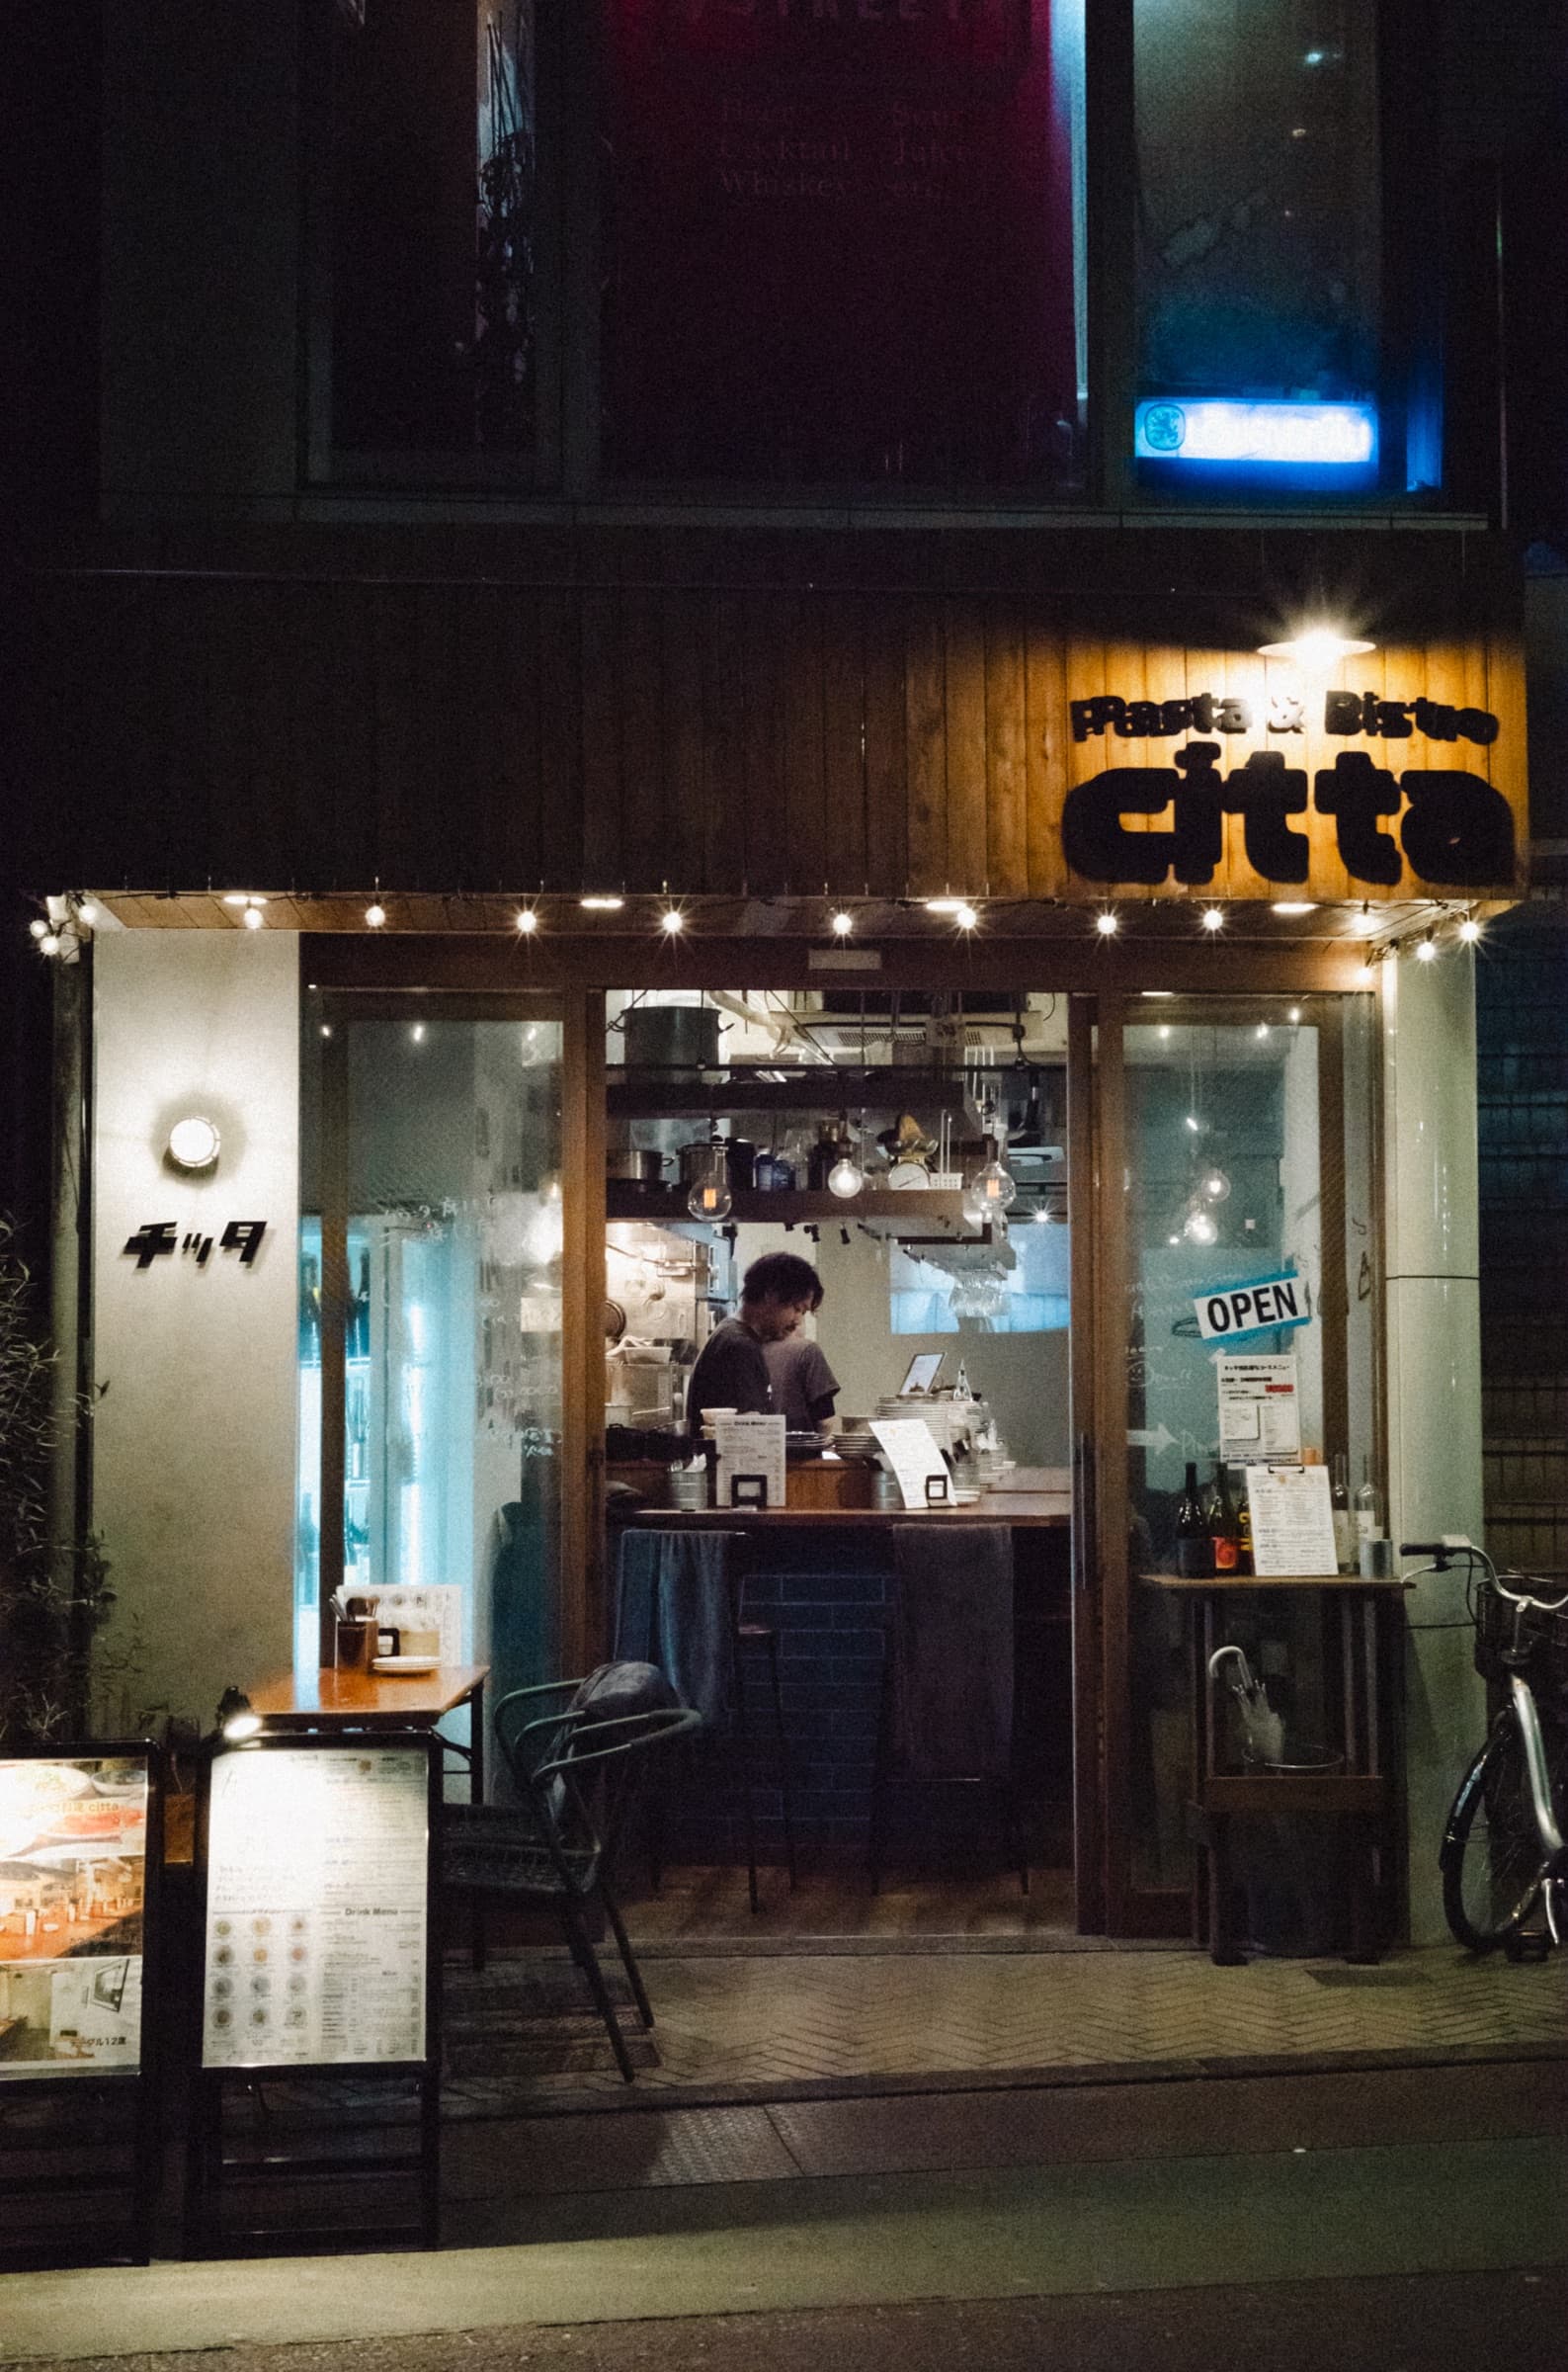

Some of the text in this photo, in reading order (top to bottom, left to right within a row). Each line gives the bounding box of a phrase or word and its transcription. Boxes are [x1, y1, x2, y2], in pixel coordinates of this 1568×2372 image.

[1070, 693, 1252, 741] Pasta
[1325, 691, 1498, 745] Bistro
[1062, 741, 1516, 885] citta
[1207, 1282, 1298, 1332] OPEN
